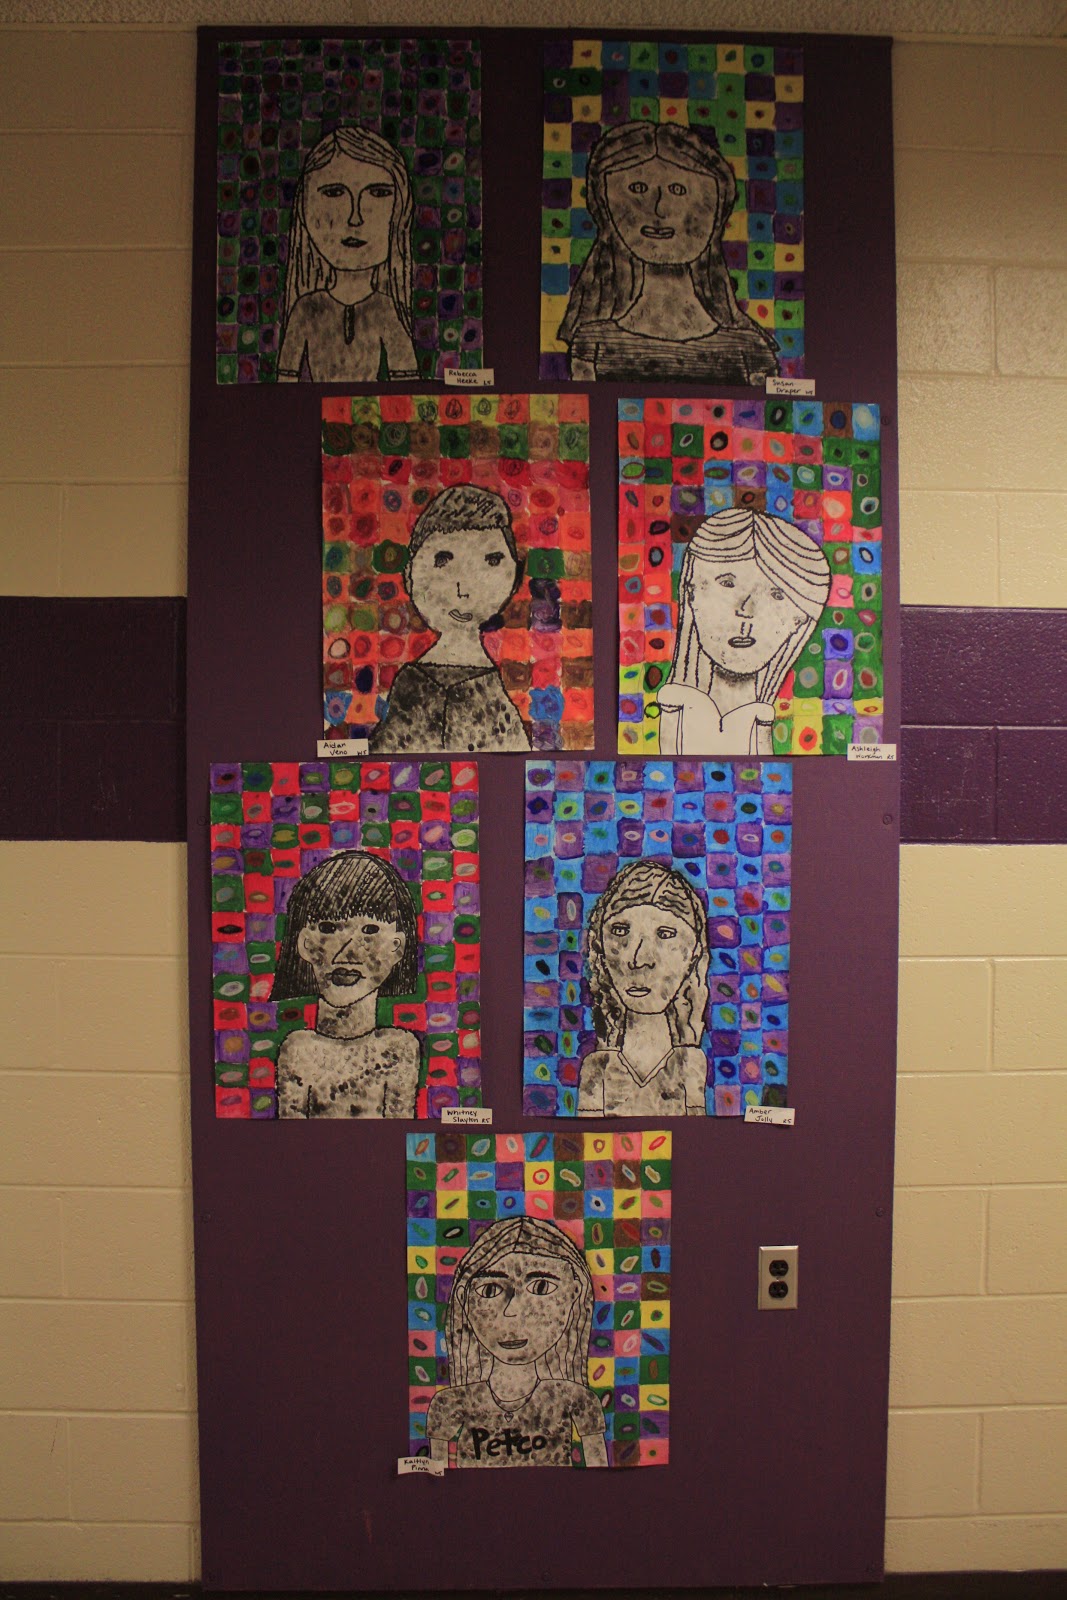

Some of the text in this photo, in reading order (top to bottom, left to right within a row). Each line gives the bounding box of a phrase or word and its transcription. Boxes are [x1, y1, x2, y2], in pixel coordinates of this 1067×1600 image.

[448, 369, 477, 377] Rebecca
[776, 387, 801, 395] Draper
[851, 745, 880, 754] Ashleigh
[754, 1115, 772, 1123] Jolly
[471, 1427, 548, 1460] Petco
